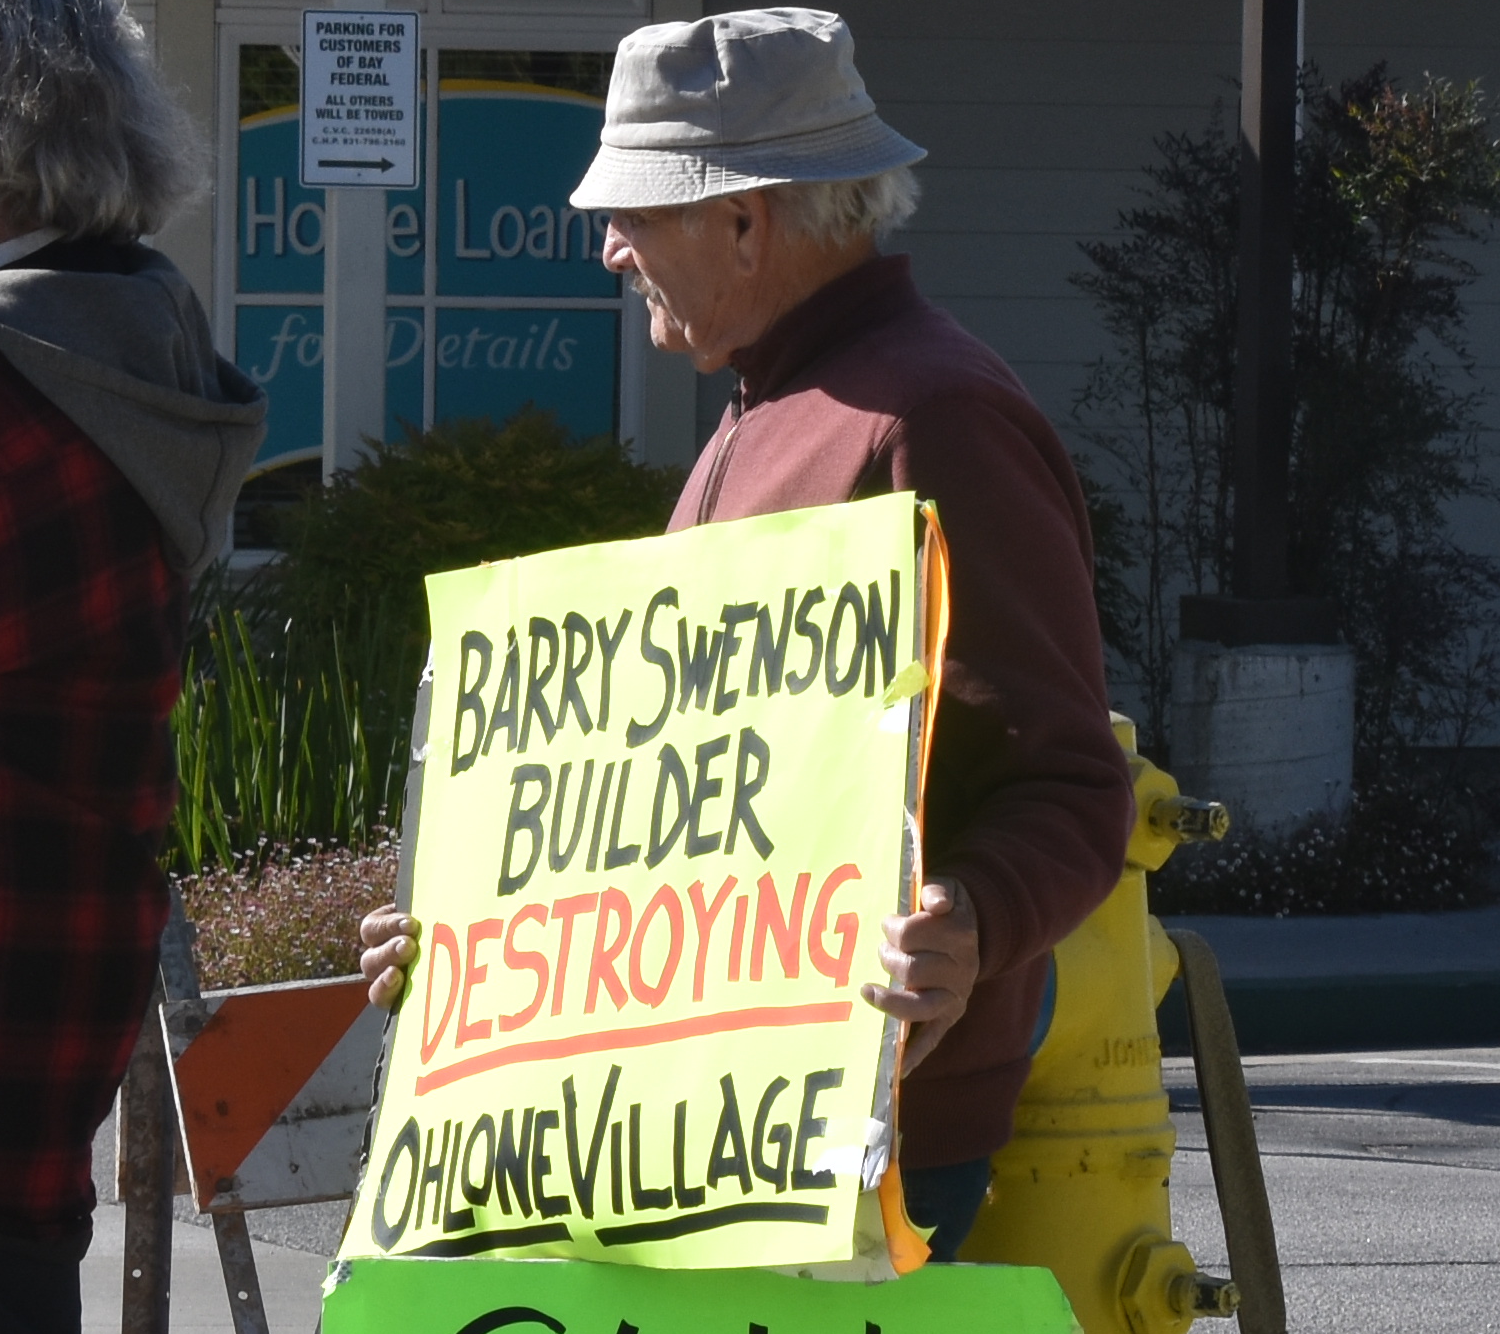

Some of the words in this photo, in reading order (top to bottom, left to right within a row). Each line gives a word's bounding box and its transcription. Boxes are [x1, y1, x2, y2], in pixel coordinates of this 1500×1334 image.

[315, 22, 375, 36] PARKING
[379, 23, 405, 37] FOR
[319, 39, 401, 53] CUSTOMERS
[330, 72, 390, 86] FEDERAL
[336, 56, 354, 68] OF
[358, 56, 384, 69] BAY
[315, 108, 342, 120] WILL
[346, 109, 360, 120] BE
[364, 109, 404, 121] TOWED
[325, 95, 346, 106] ALL
[349, 95, 394, 107] OTHERS
[245, 175, 421, 258] Hoe
[252, 313, 324, 384] fo
[385, 316, 578, 371] Details
[451, 608, 633, 776] BARRY
[626, 569, 901, 747] SWENSON
[498, 726, 775, 896] BUILDER
[419, 863, 862, 1065] DESTROYING
[371, 1103, 572, 1252] OHLONE
[562, 1064, 845, 1219] VILLAGE
